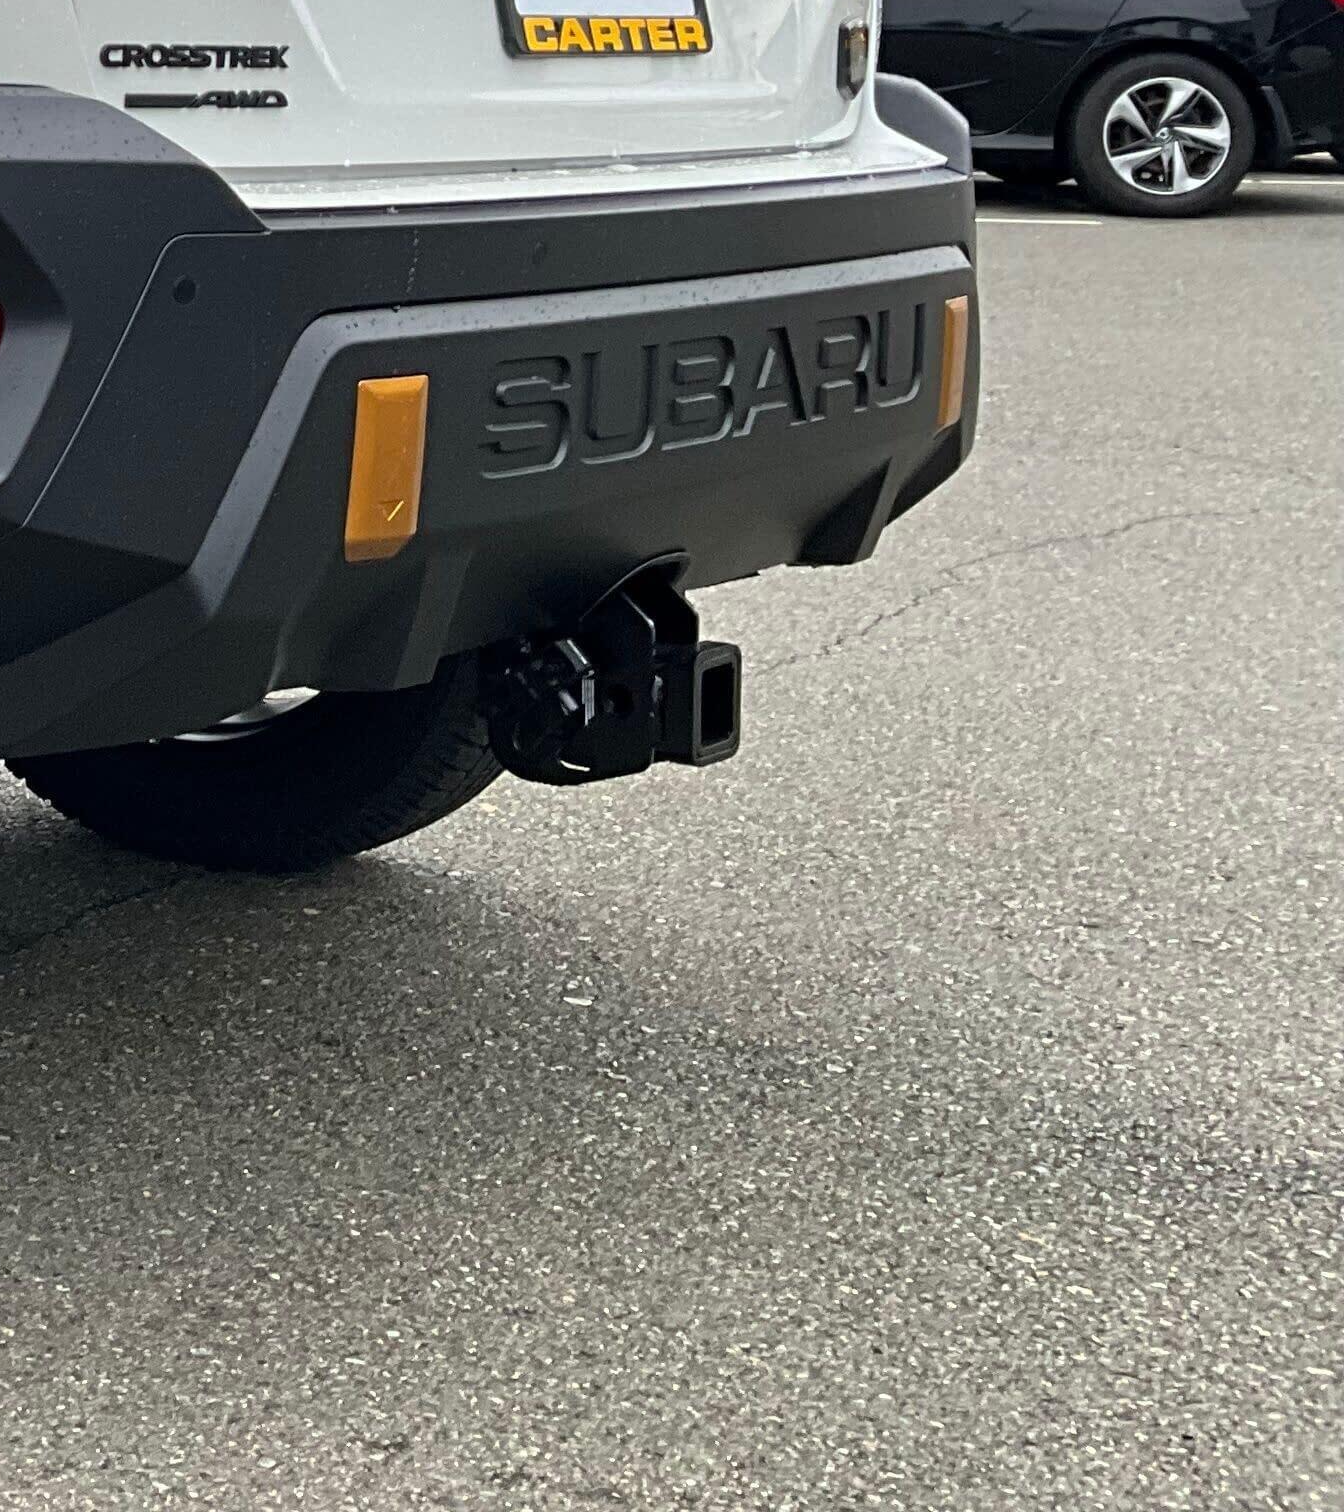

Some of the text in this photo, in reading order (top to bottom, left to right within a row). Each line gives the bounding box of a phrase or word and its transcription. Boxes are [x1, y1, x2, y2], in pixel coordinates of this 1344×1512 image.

[522, 16, 709, 52] CARTER
[99, 44, 290, 69] CROSSTREK
[195, 90, 288, 108] AWD
[480, 302, 928, 480] SUBARU
